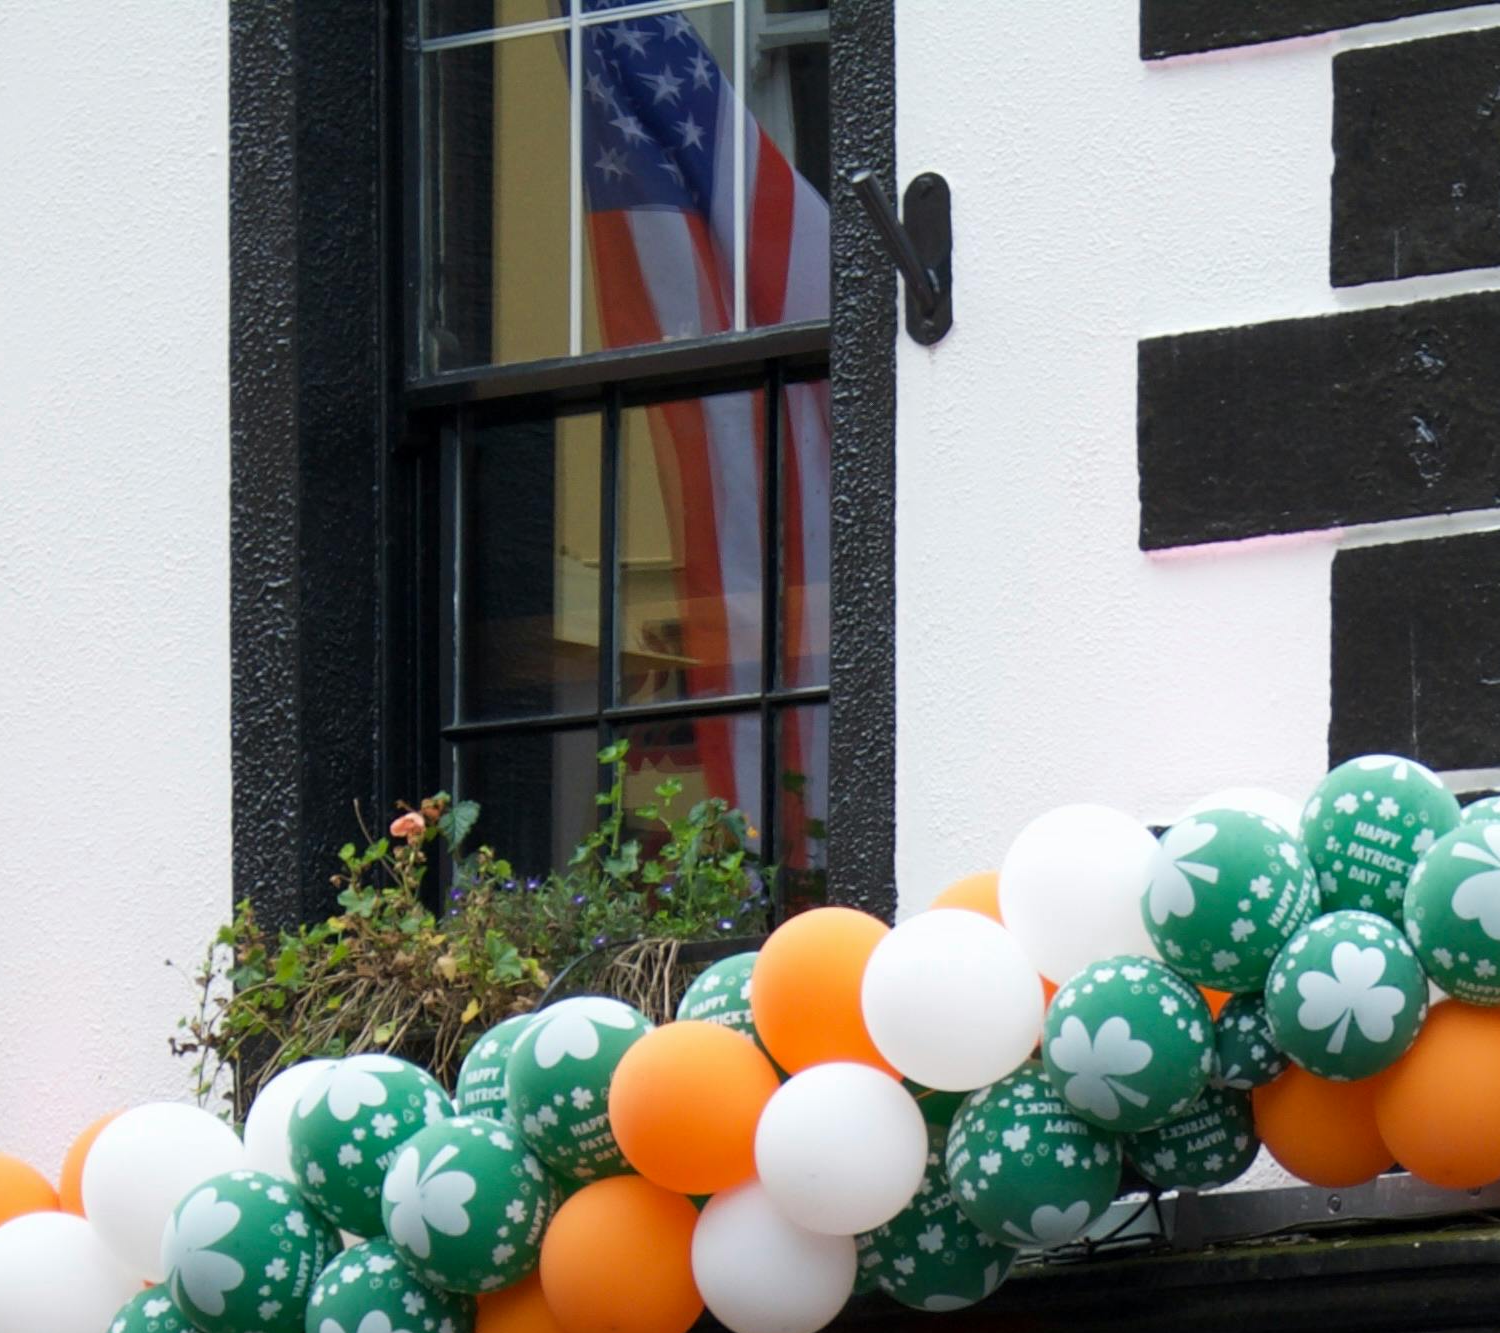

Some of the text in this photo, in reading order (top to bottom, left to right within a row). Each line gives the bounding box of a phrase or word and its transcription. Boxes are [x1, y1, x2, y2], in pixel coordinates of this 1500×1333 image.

[1354, 820, 1402, 850] HAPPY
[1347, 864, 1381, 887] DAY!
[1267, 880, 1297, 928] HAPPY
[465, 1066, 501, 1083] HAPPY
[1013, 1102, 1069, 1118] TRICK'S
[1043, 1118, 1089, 1137] HAPPY
[1159, 1111, 1223, 1141] PATRICK'S
[1186, 1127, 1227, 1154] HAPPY
[526, 1196, 547, 1245] HAPPY
[291, 1250, 311, 1298] HAPPY
